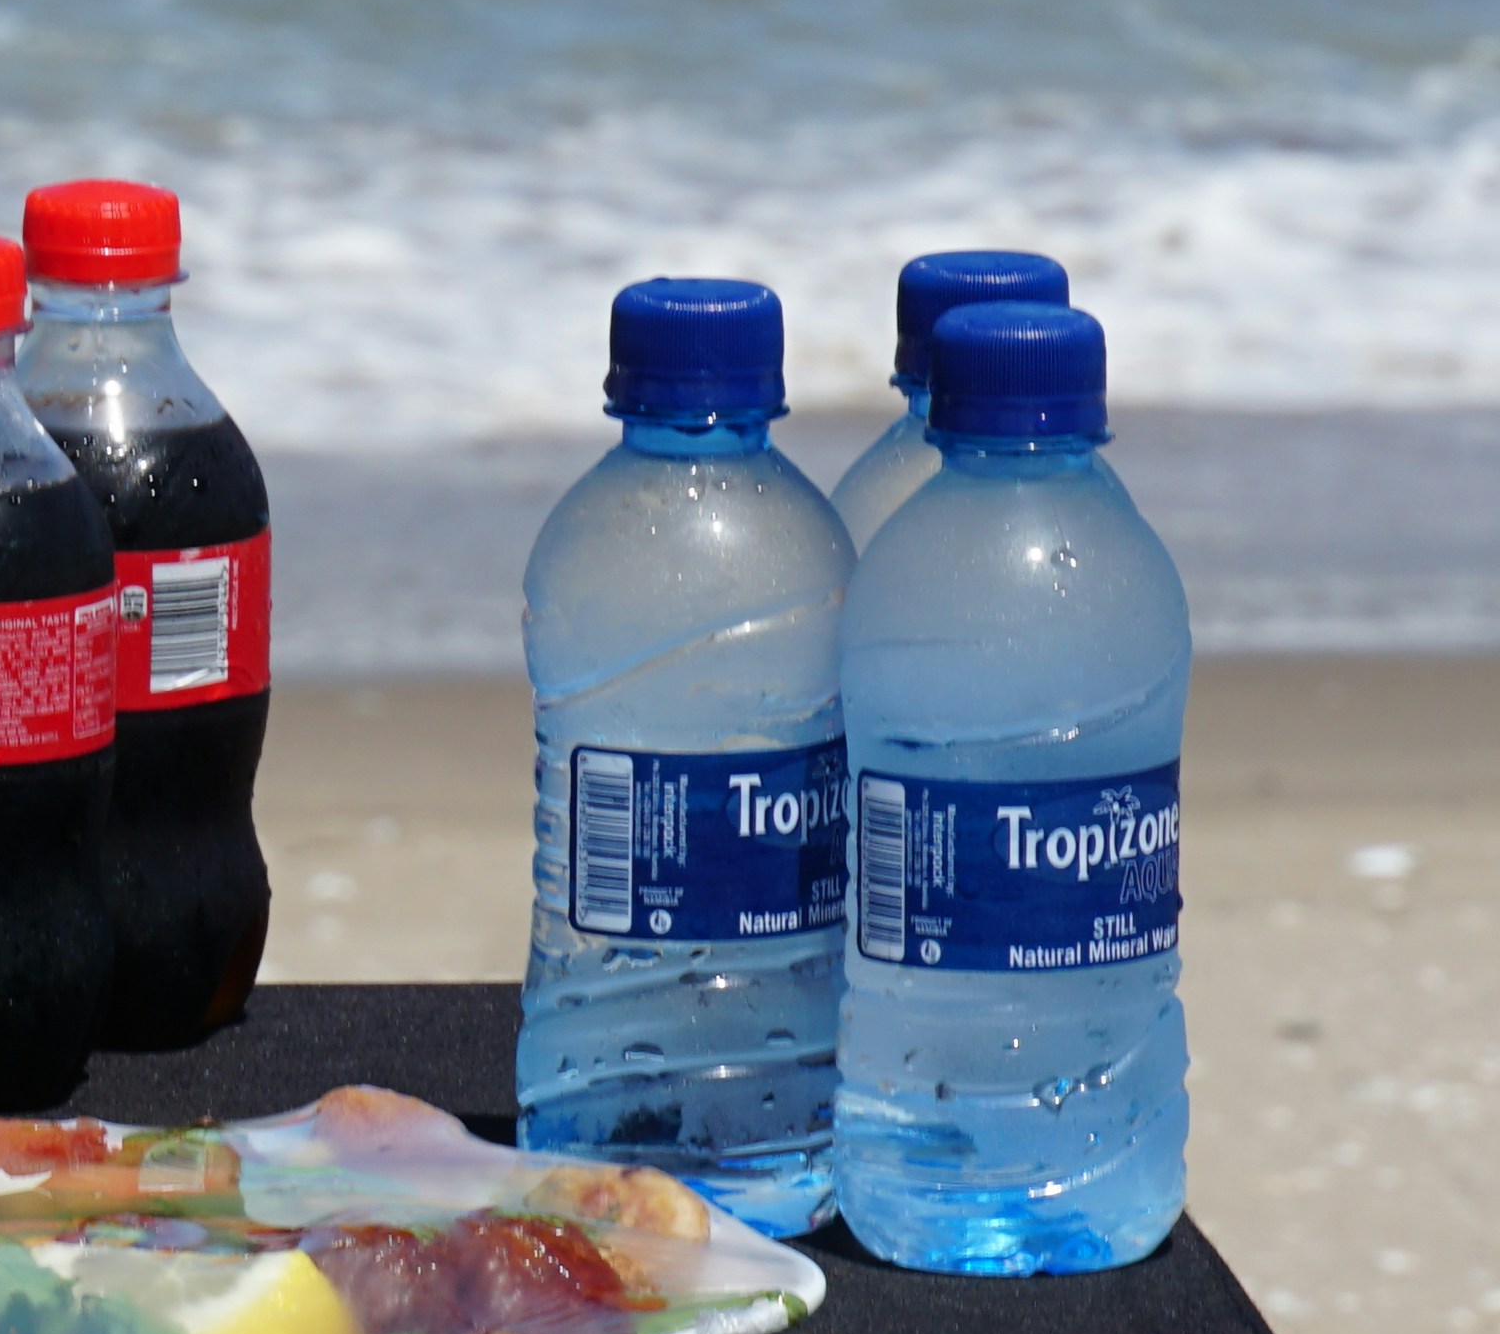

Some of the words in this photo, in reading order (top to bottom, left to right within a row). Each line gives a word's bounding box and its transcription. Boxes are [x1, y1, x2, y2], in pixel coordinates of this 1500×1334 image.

[41, 612, 70, 625] TASTE
[997, 801, 1179, 882] Tropizone
[812, 874, 841, 904] STILL
[739, 907, 802, 936] Natural
[1093, 912, 1136, 940] STILL
[1009, 942, 1081, 968] Natural
[1089, 930, 1148, 964] Mineral
